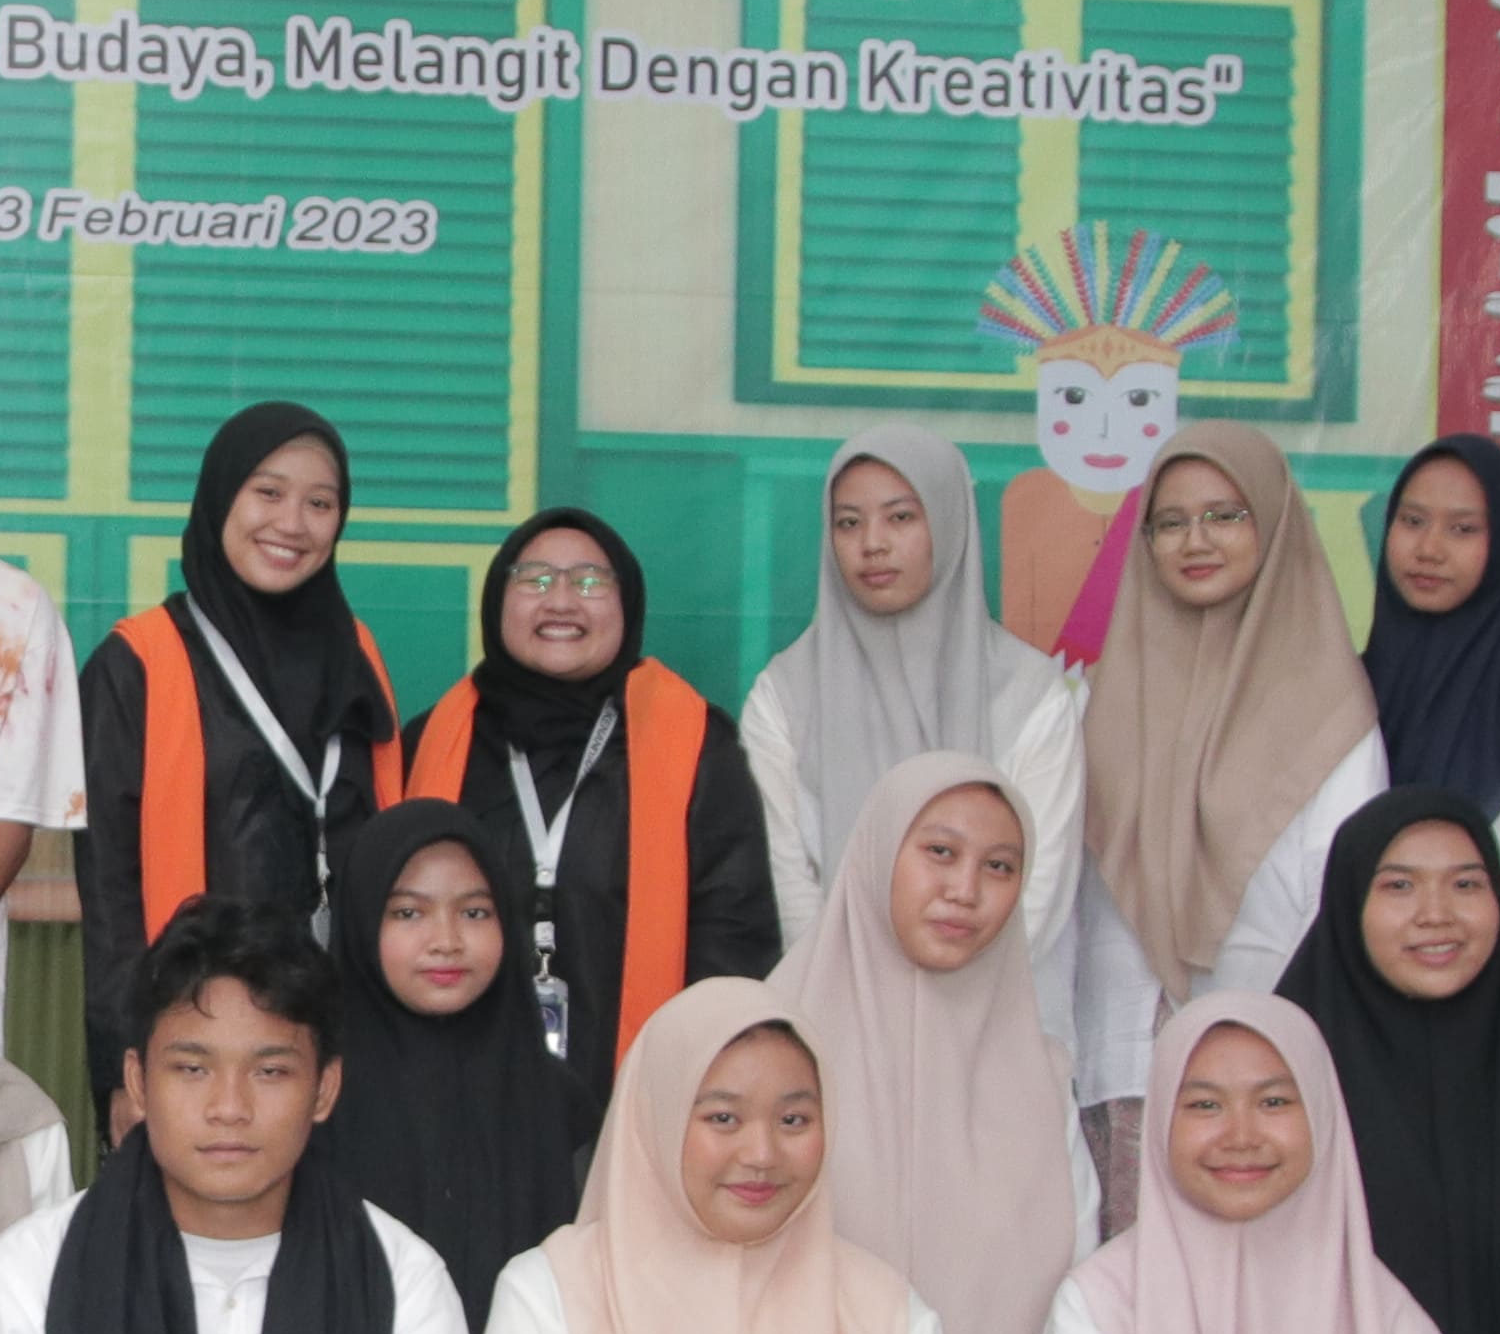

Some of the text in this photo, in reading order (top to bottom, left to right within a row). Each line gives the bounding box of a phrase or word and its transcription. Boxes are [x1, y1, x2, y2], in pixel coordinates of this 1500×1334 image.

[6, 13, 267, 91] Budaya,
[294, 24, 573, 102] Melangit
[600, 37, 839, 113] Dengan
[866, 48, 1235, 117] Kreativitas"
[46, 195, 279, 242] Februari
[297, 204, 431, 247] 2023
